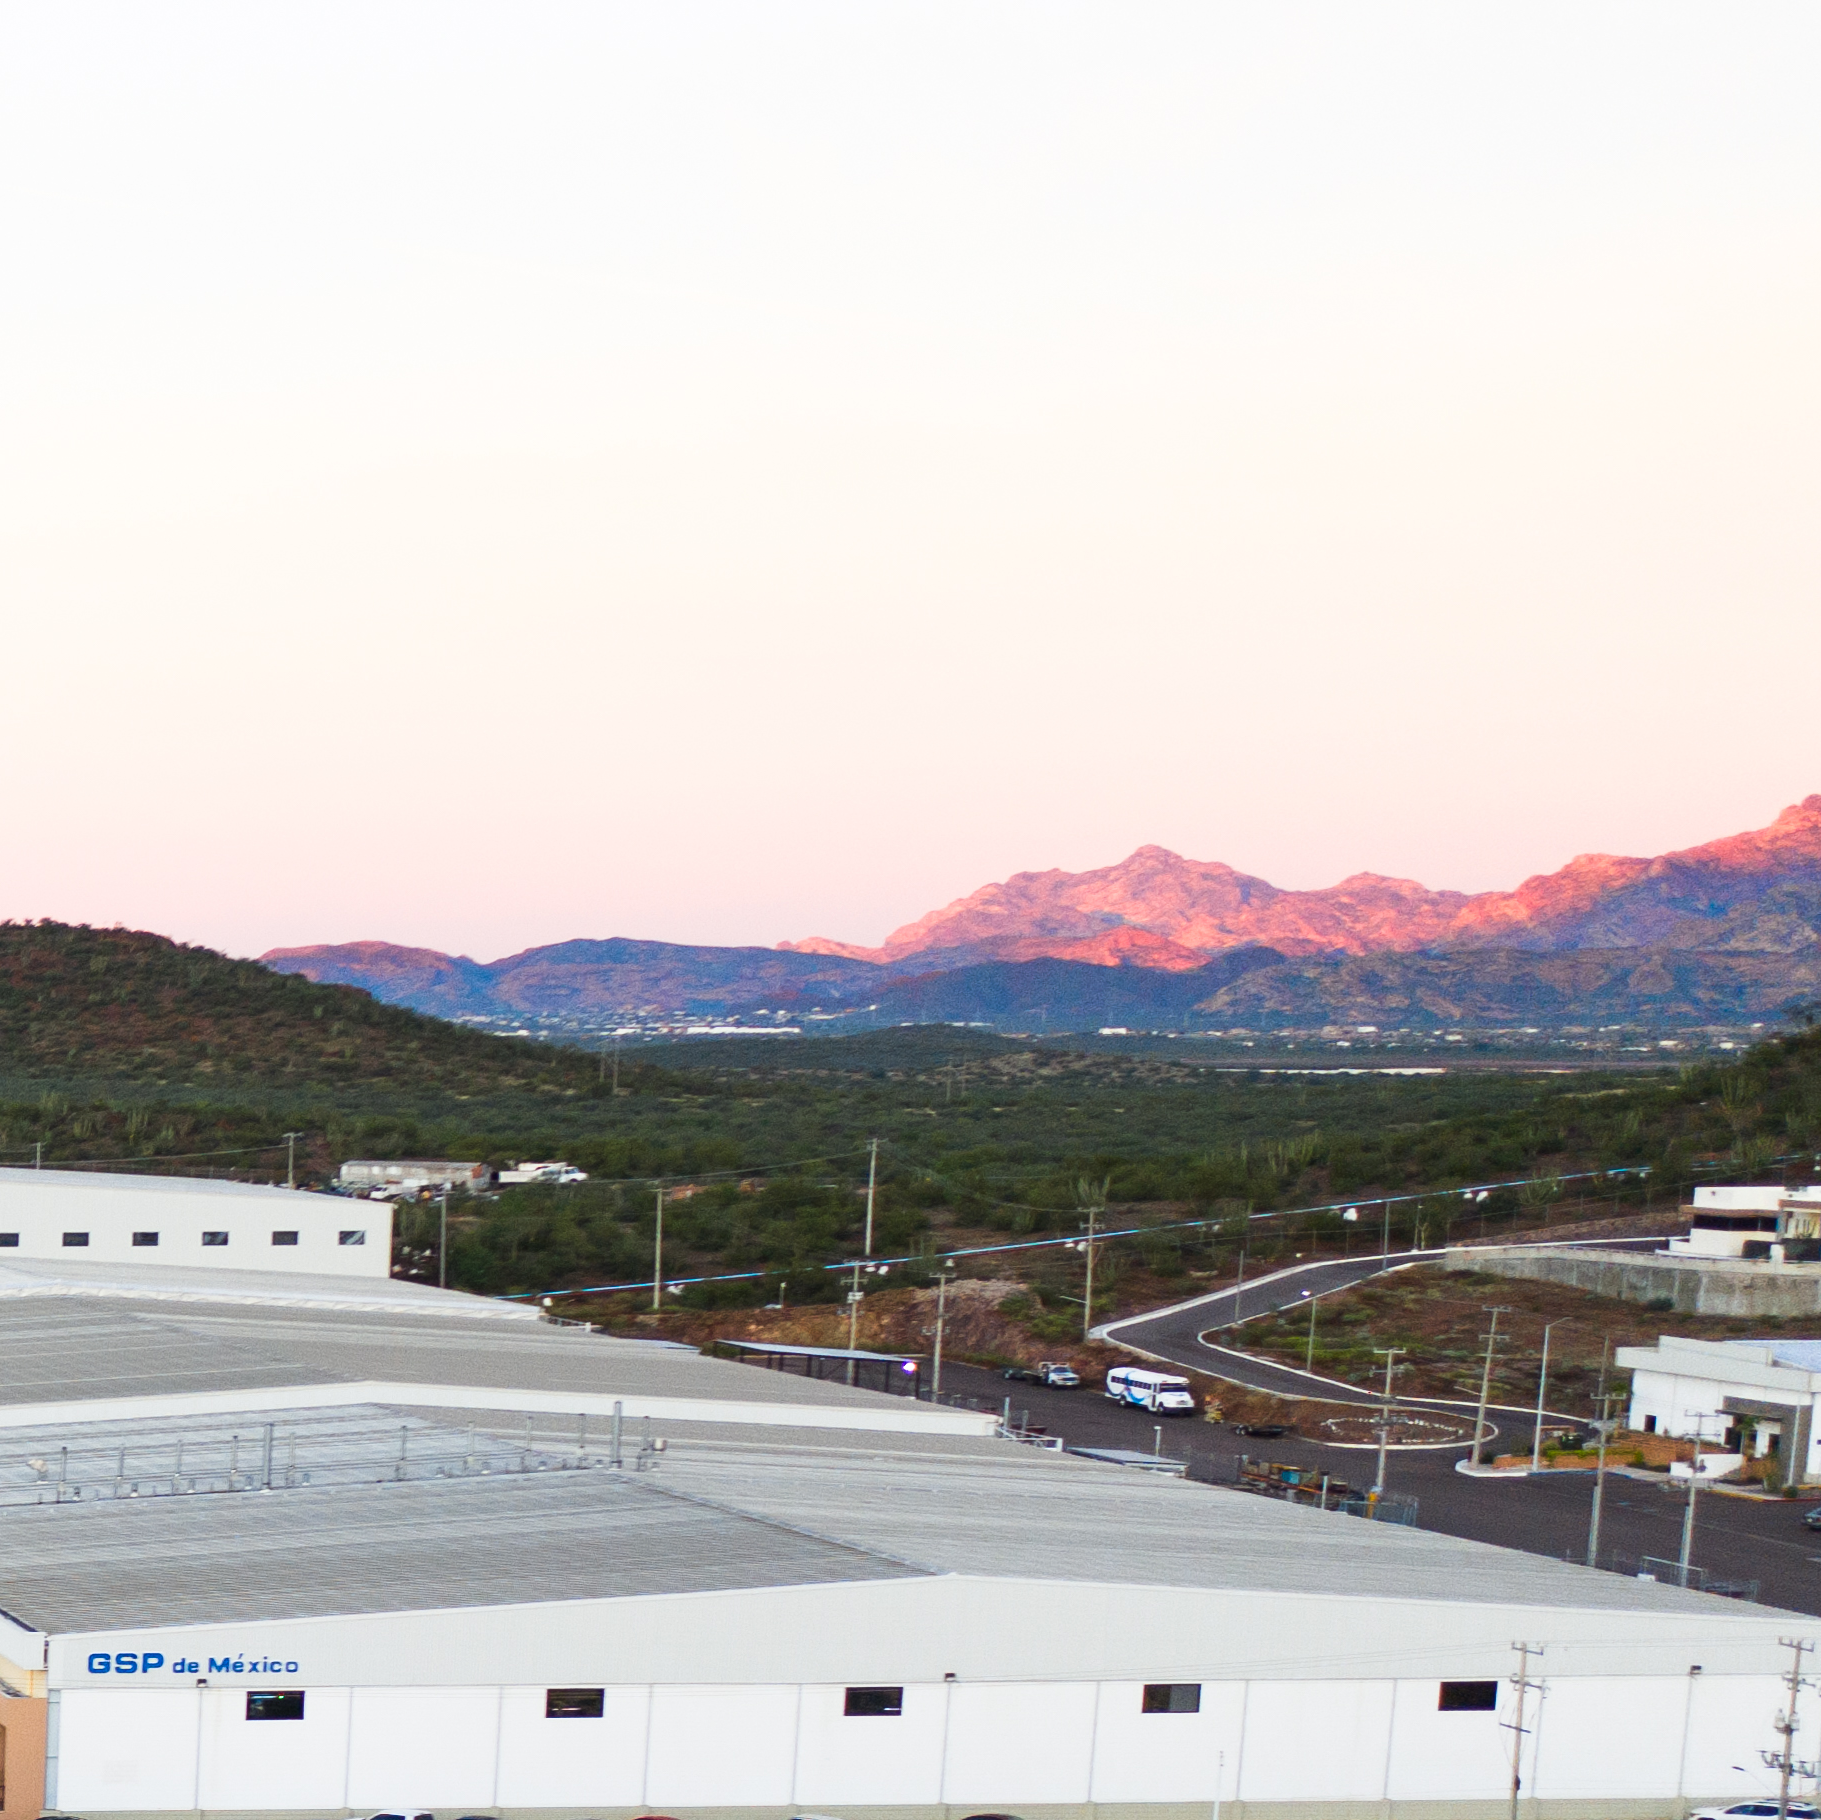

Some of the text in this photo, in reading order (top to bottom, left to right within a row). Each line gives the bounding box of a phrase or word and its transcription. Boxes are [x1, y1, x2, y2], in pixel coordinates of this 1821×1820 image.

[88, 1653, 299, 1674] GSP de México
